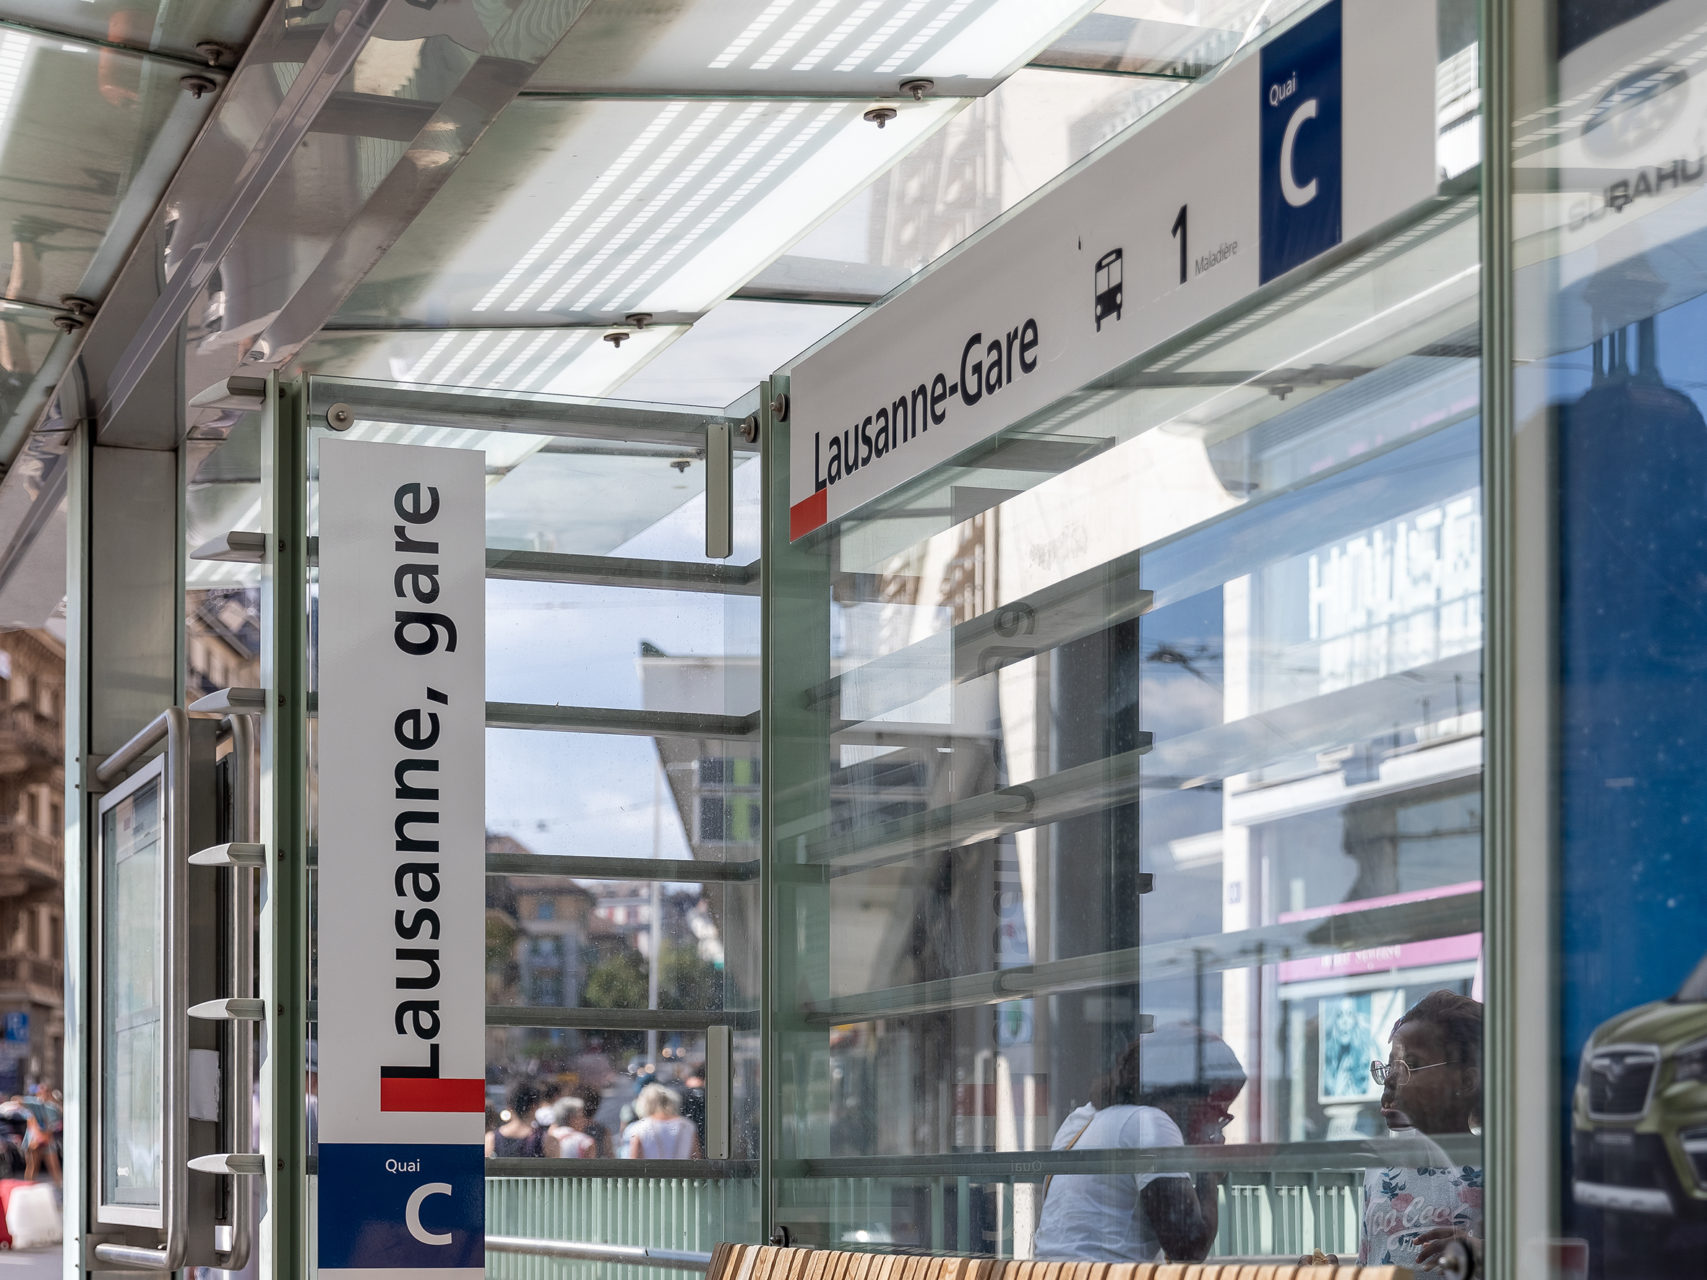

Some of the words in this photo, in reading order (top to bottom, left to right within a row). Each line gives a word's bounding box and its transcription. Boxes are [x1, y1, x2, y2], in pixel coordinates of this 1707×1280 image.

[1269, 71, 1297, 107] Quai
[1279, 97, 1318, 209] C
[1170, 203, 1188, 285] 1
[1194, 239, 1239, 276] Maladière
[814, 317, 1039, 493] Lausanne-Gare
[393, 481, 458, 656] gare
[380, 686, 449, 1079] Lausanne,
[385, 1158, 421, 1175] Quai
[404, 1182, 453, 1246] C
[1365, 1197, 1397, 1235] Too
[1402, 1196, 1470, 1228] Cool
